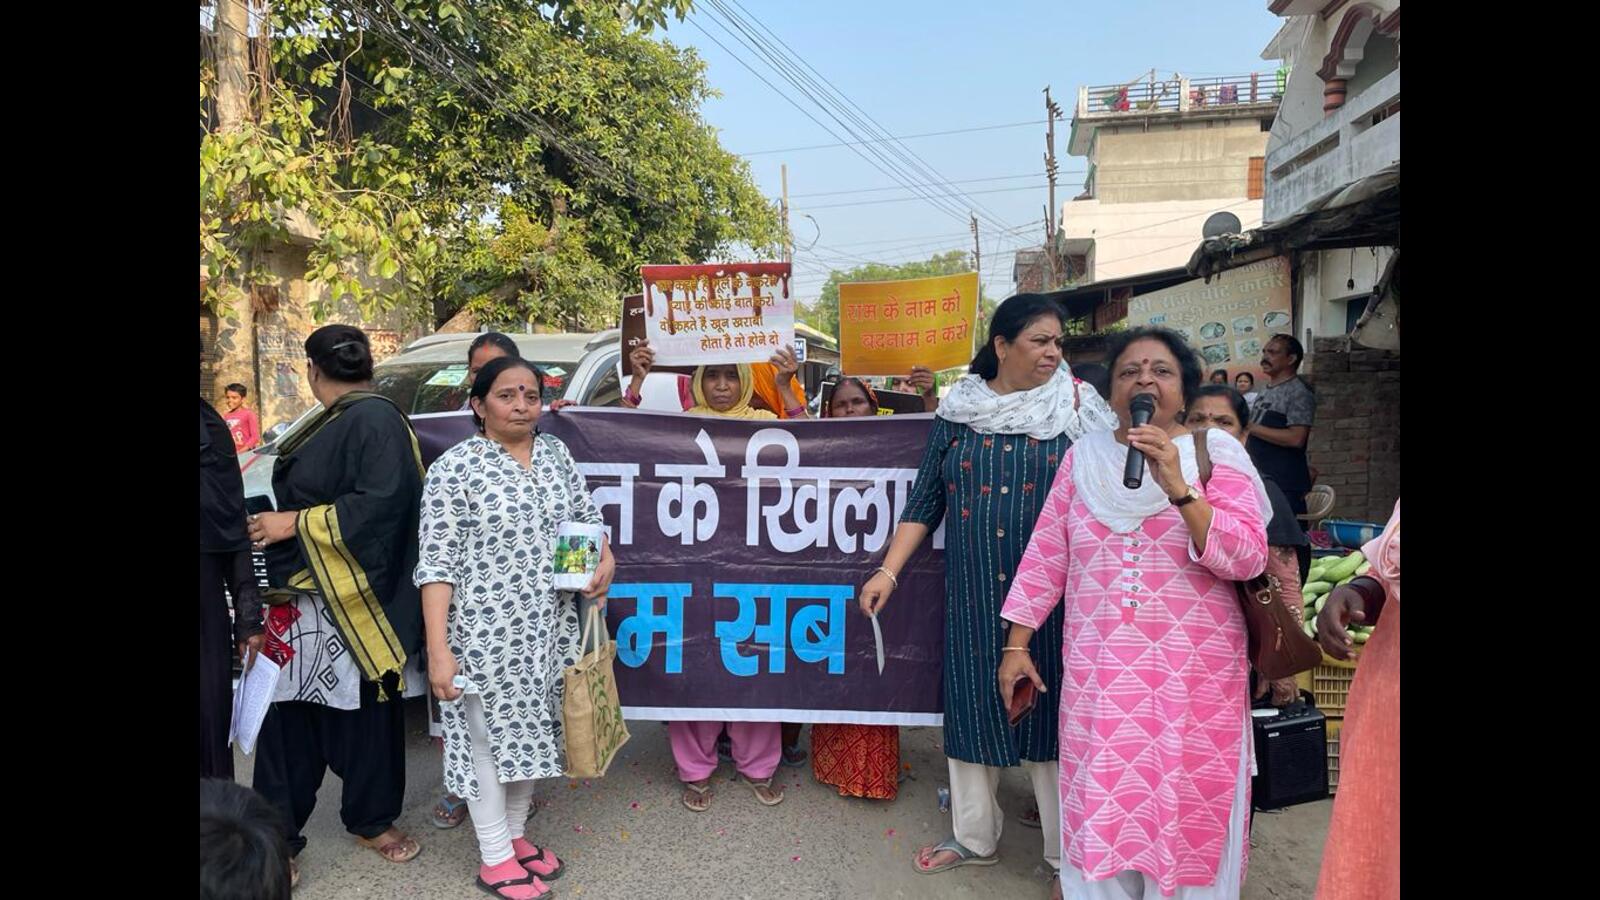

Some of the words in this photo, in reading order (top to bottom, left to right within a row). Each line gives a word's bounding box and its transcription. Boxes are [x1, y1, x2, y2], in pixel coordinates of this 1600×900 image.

[694, 296, 708, 310] की
[753, 291, 775, 307] करो
[847, 303, 877, 321] राम
[883, 296, 900, 320] के
[905, 299, 937, 318] नाम
[942, 289, 960, 314] को
[671, 316, 698, 333] कहते
[710, 317, 730, 334] खून
[700, 333, 722, 351] होता
[734, 332, 746, 348] तो
[747, 330, 767, 348] होने
[768, 329, 779, 346] दो
[862, 331, 920, 349] बदनाम
[925, 329, 937, 344] न
[942, 317, 969, 342] करो
[581, 463, 640, 545] त
[655, 430, 727, 546] के
[741, 427, 945, 554] खिला
[604, 582, 693, 674] म
[712, 582, 855, 677] सब
